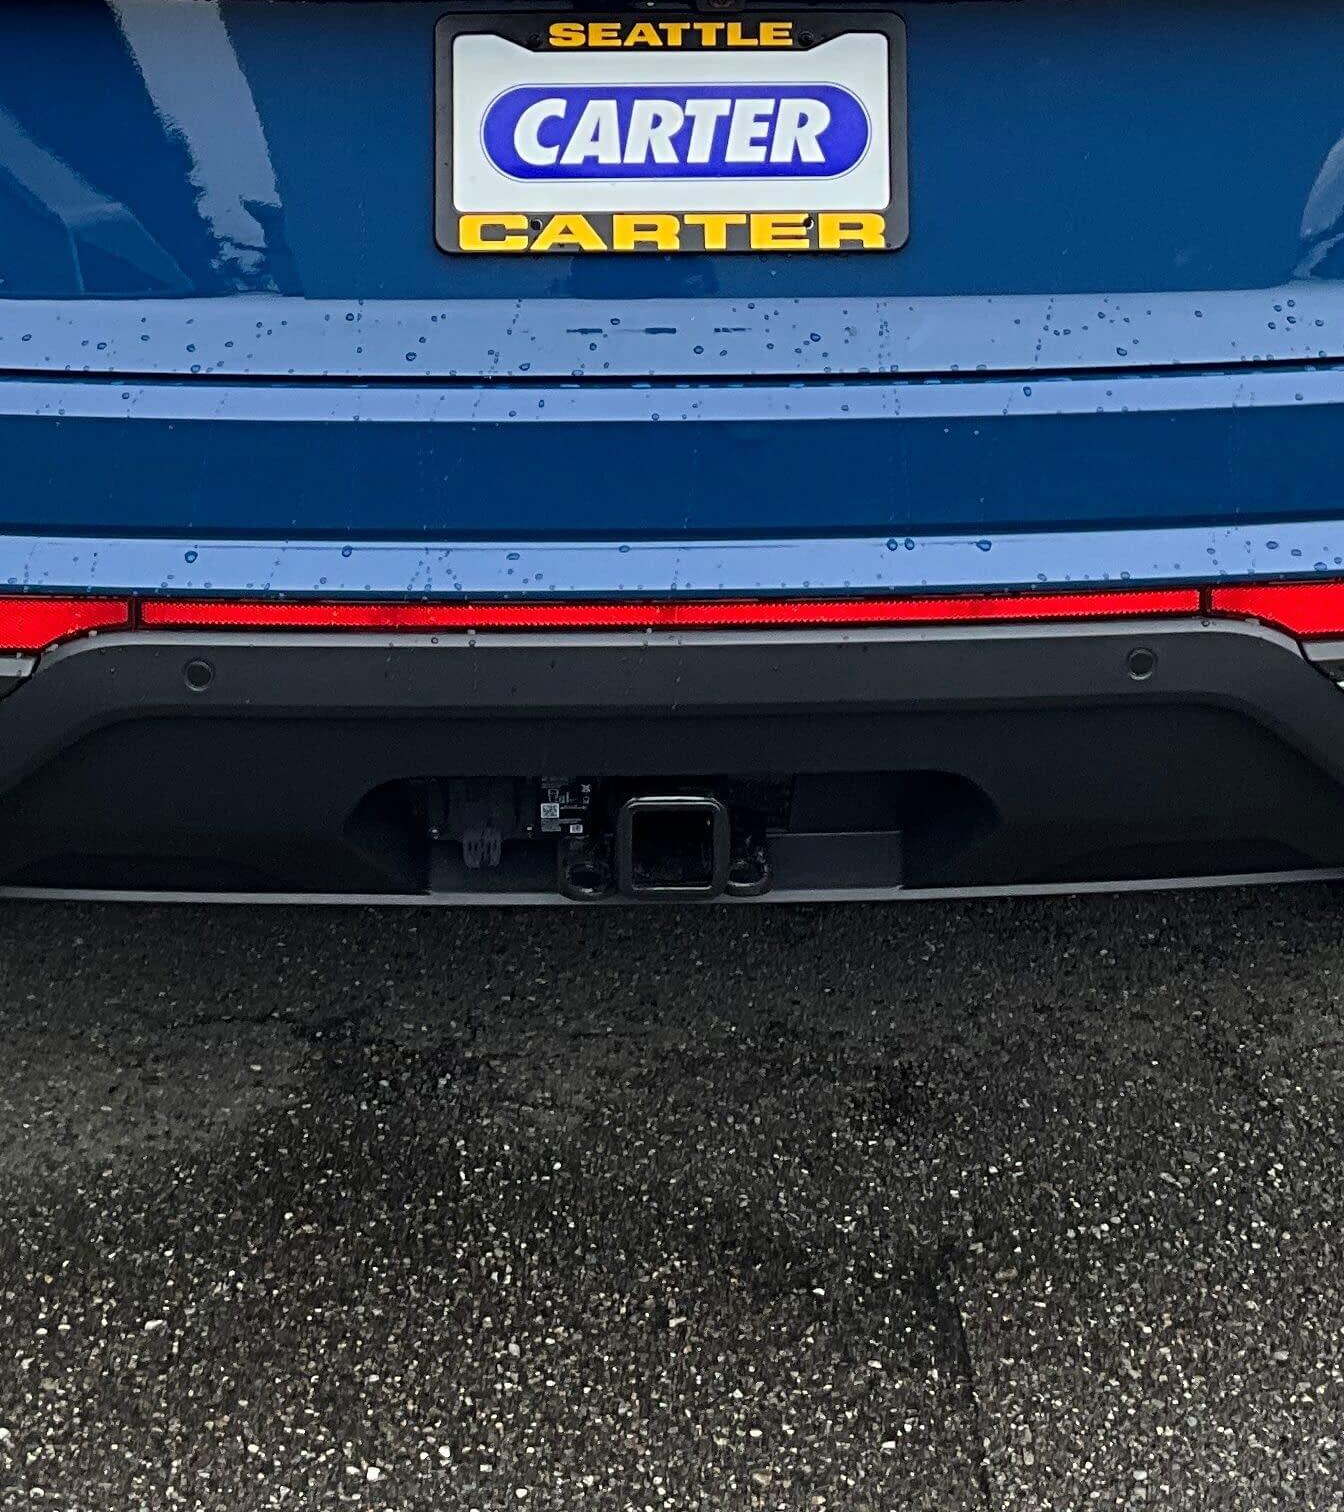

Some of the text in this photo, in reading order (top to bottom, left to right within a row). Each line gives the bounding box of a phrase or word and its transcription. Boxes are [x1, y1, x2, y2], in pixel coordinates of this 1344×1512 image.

[548, 21, 794, 48] SEATTLE
[513, 97, 832, 167] CARTER
[458, 213, 887, 252] CARTER
